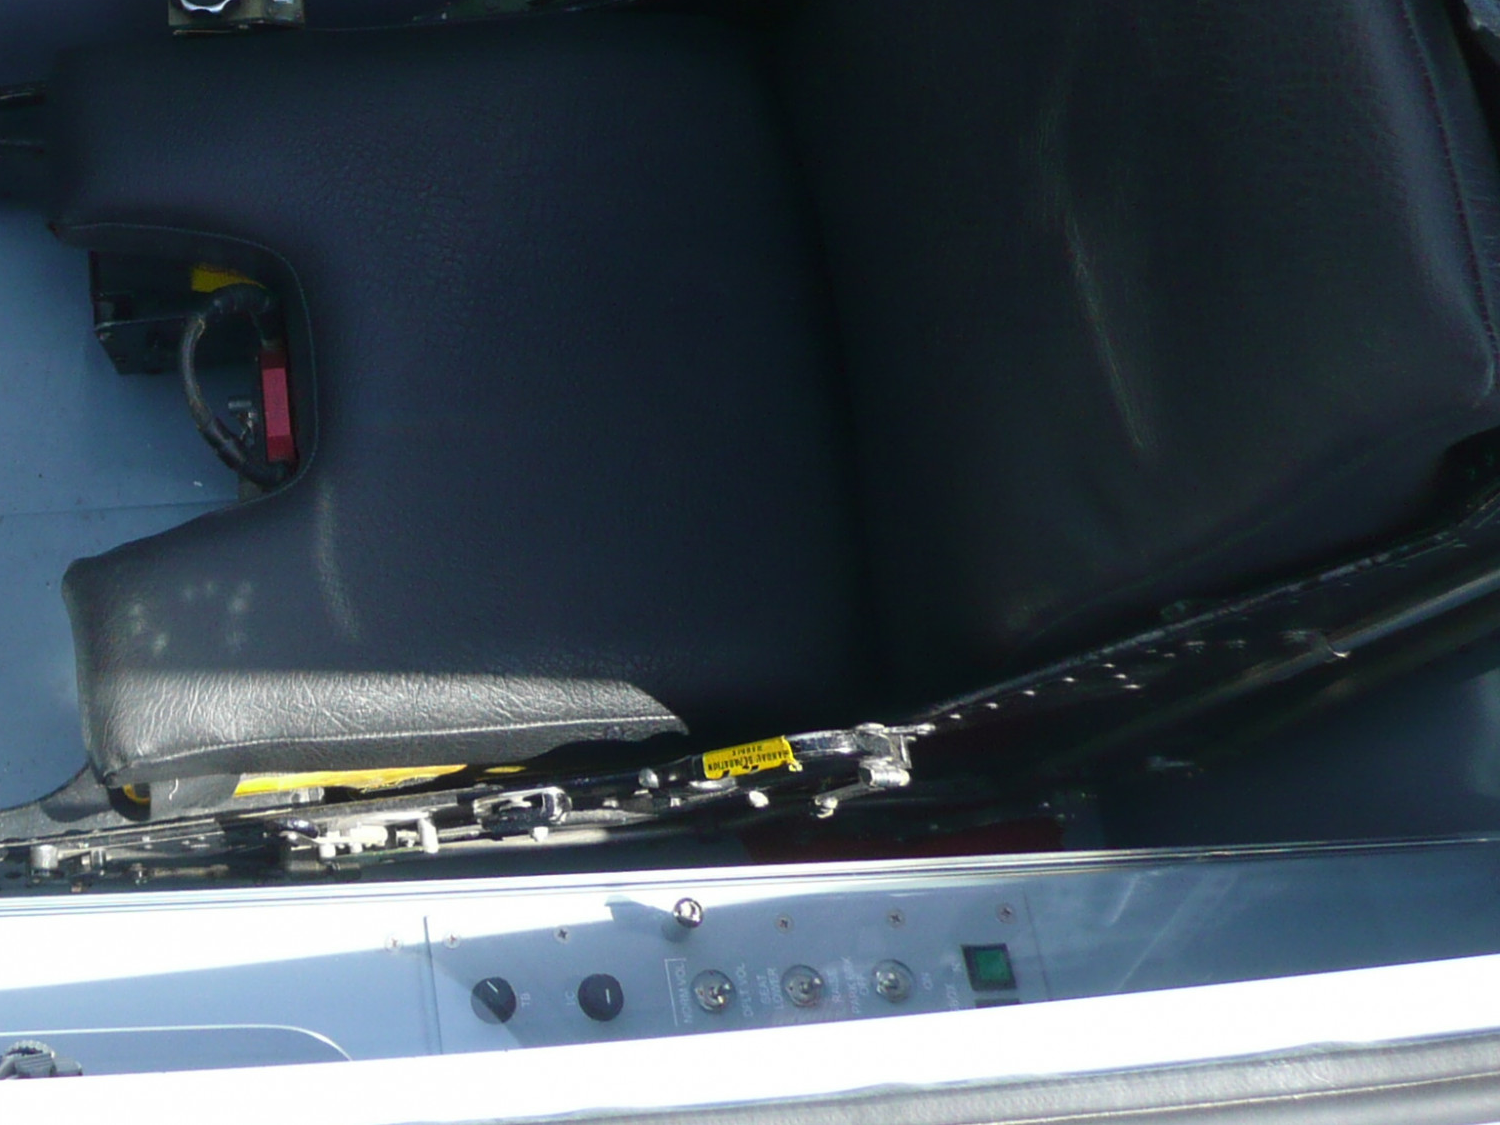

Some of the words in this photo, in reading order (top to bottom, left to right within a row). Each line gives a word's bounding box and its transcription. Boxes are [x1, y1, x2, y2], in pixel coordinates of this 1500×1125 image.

[675, 963, 686, 986] VOL
[736, 963, 747, 985] VOL
[858, 974, 869, 995] OFF
[921, 972, 933, 990] ON
[756, 975, 770, 1004] SEAT
[767, 968, 784, 1009] LOWER
[847, 983, 862, 1013] PARK
[680, 988, 692, 1023] NORM
